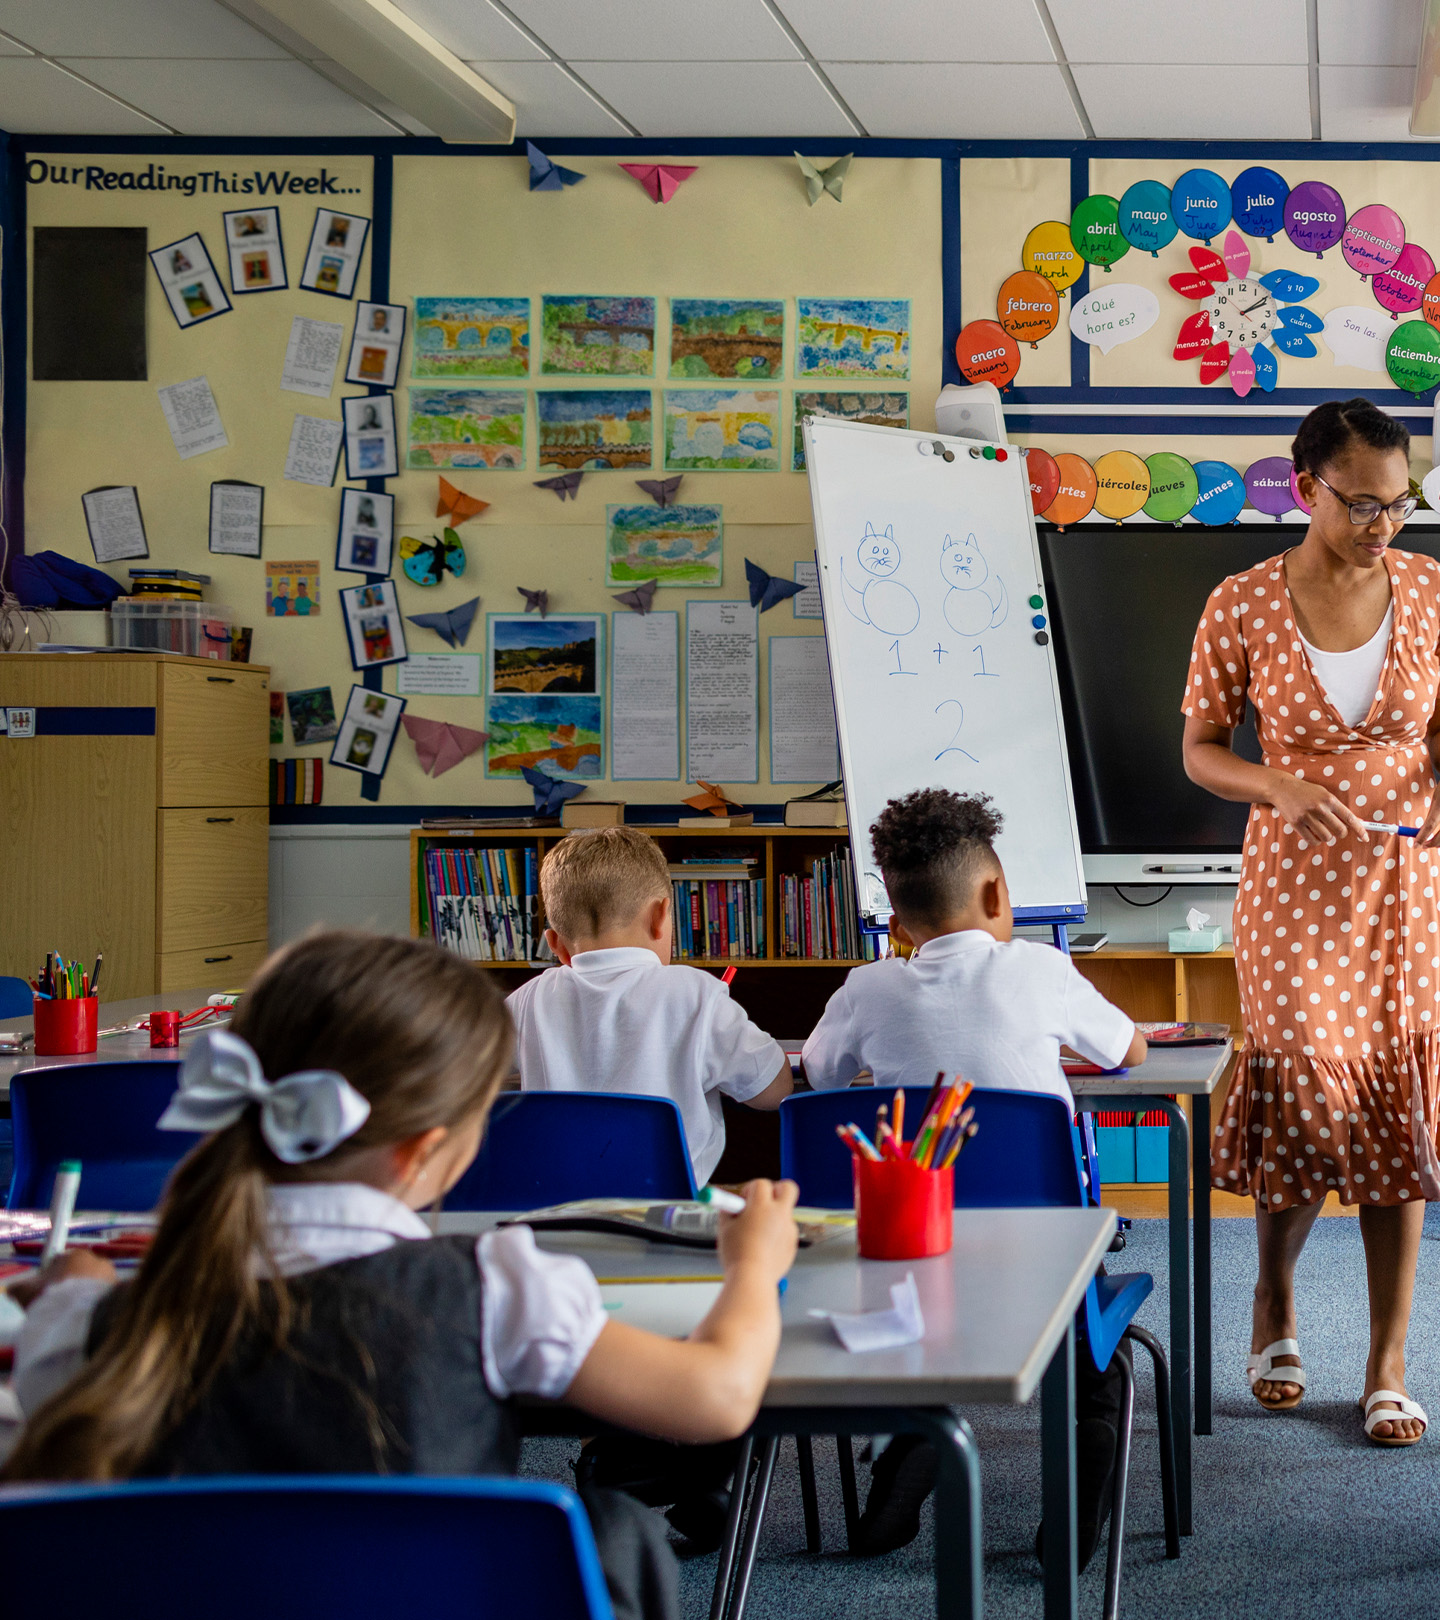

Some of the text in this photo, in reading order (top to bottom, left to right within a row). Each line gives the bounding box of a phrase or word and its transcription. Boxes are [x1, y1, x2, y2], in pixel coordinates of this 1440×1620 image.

[1184, 196, 1218, 211] junio
[1245, 195, 1274, 212] julio
[1131, 210, 1167, 225] mayo
[1186, 215, 1219, 232] June
[1241, 213, 1274, 229] July
[1293, 210, 1336, 224] agosto
[1087, 223, 1116, 236] abril
[1128, 223, 1158, 243] May
[1290, 223, 1335, 247] August
[1080, 236, 1114, 253] April
[1346, 224, 1402, 255] septiembre
[1034, 251, 1074, 261] marzo
[1234, 251, 1249, 260] punto
[1343, 239, 1392, 266] September
[1198, 261, 1214, 272] menos
[1239, 284, 1246, 292] 12
[1373, 274, 1416, 304] October
[1006, 298, 1052, 314] febrero
[1214, 309, 1220, 317] 9
[1265, 310, 1271, 318] 3
[1004, 319, 1051, 331] February
[1087, 313, 1135, 335] hora es?
[1290, 318, 1311, 329] cuarto
[1344, 319, 1361, 332] Son
[1201, 338, 1210, 346] 20
[971, 346, 1006, 363] enero
[964, 360, 1009, 378] January
[1263, 364, 1273, 372] 25
[1389, 360, 1439, 381] December
[1253, 477, 1290, 487] sábad
[889, 640, 918, 675] 1
[973, 645, 999, 676] 1
